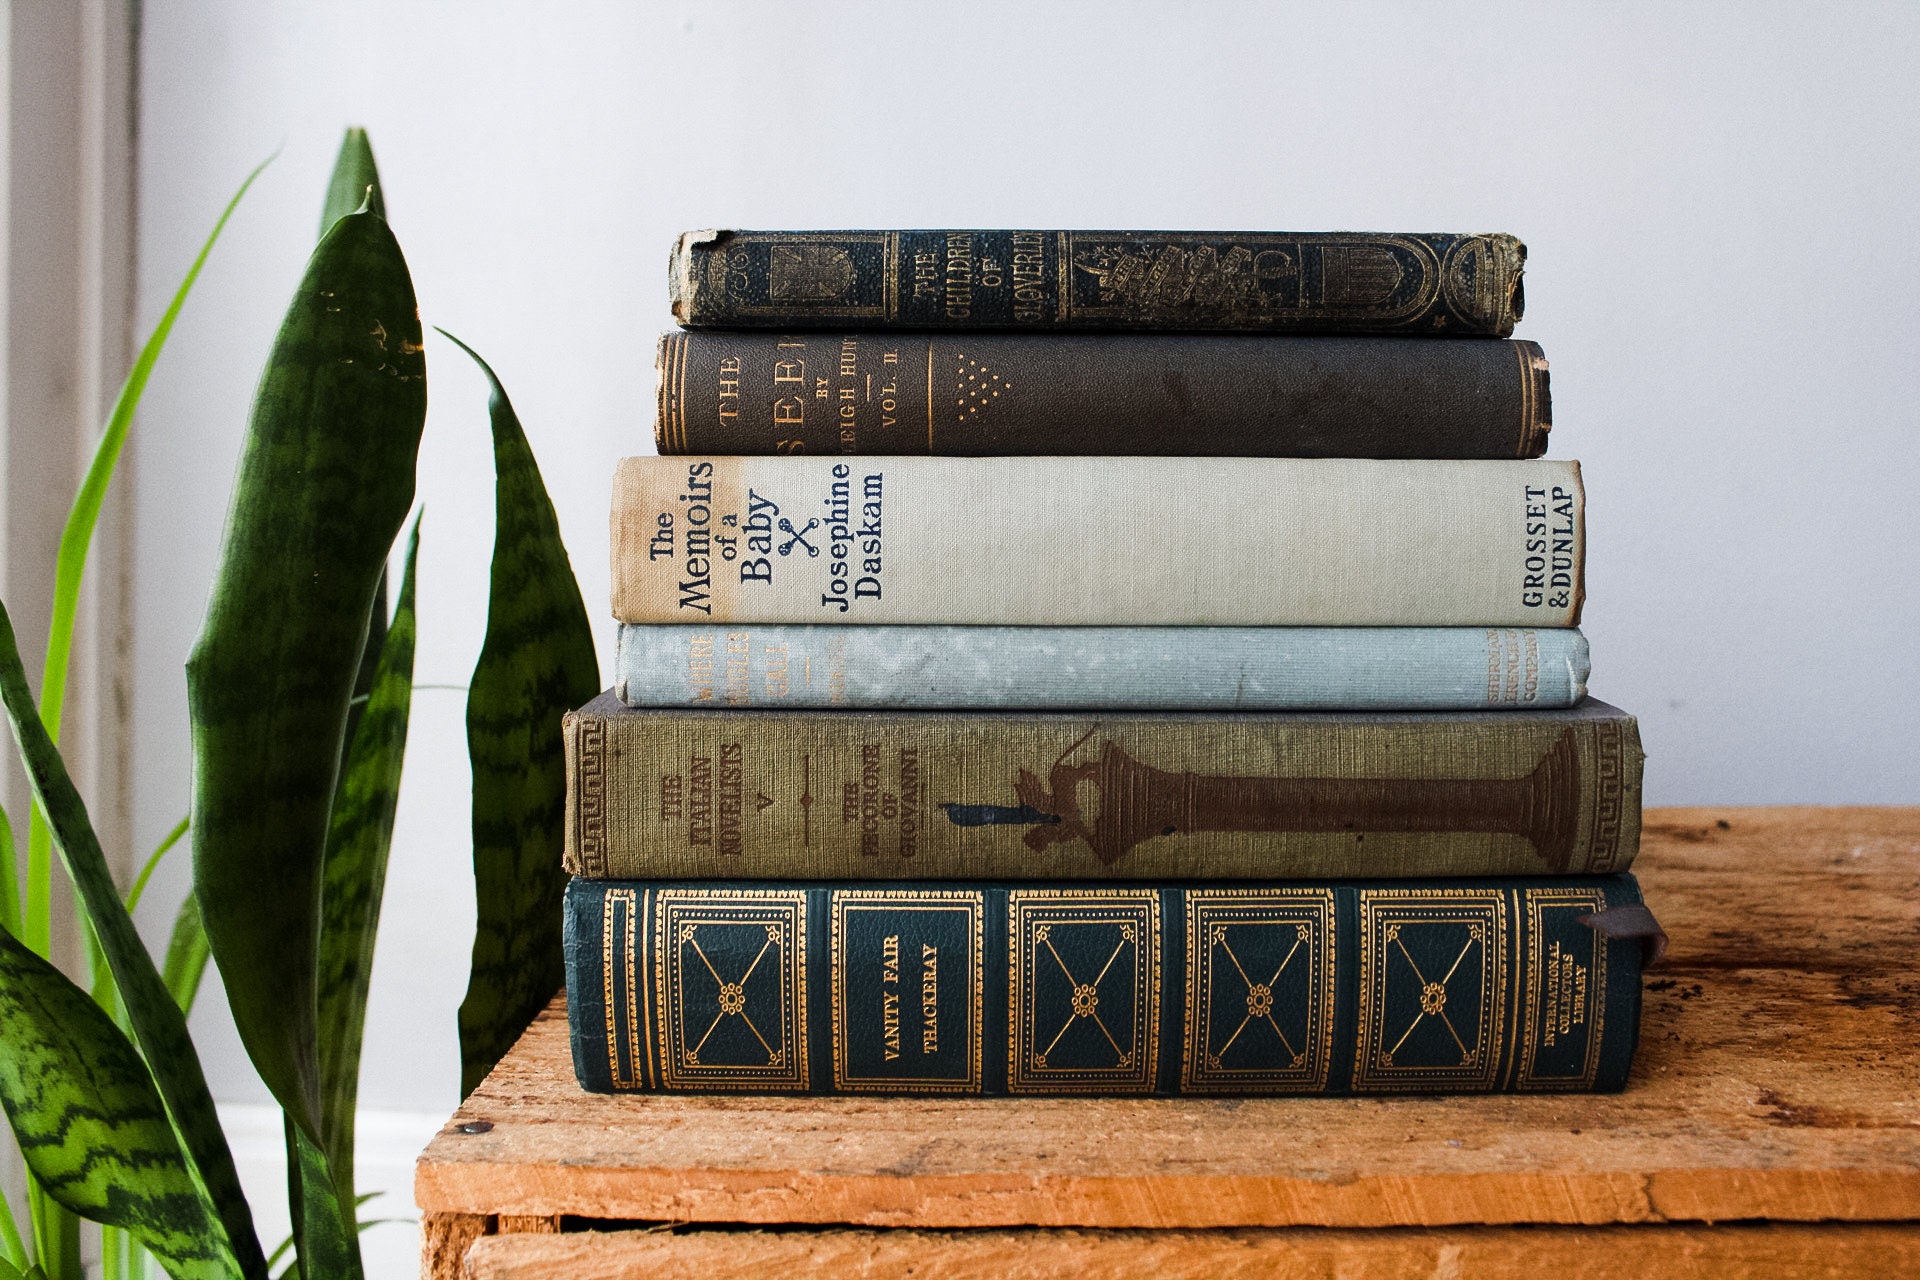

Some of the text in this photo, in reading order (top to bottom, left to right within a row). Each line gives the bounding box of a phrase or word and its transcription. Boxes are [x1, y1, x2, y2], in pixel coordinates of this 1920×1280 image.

[913, 252, 936, 297] THE
[945, 233, 972, 319] CHILDREN
[981, 257, 1003, 288] OF
[719, 356, 741, 427] THE
[816, 377, 829, 400] BY
[840, 386, 857, 454] LEIGH
[881, 375, 897, 429] VOL.
[650, 512, 674, 562] The
[678, 462, 713, 616] Memoirs
[714, 513, 738, 562] of a
[740, 488, 780, 585] Baby
[821, 463, 855, 613] Josephine
[854, 472, 884, 600] Daskam
[1522, 485, 1547, 608] GROSSET
[689, 632, 714, 703] WHERE
[725, 631, 750, 706] BUGLES
[765, 641, 790, 697] CALL
[1504, 643, 1519, 704] FRENCH
[1522, 629, 1538, 702] COMPANY
[661, 774, 682, 822] THE
[690, 755, 712, 847] ITALIAN
[719, 743, 743, 856] NOVELISTS
[757, 793, 775, 812] V
[843, 782, 859, 823] THE
[862, 745, 881, 858] PECORONE
[882, 793, 898, 820] OF
[899, 748, 919, 859] GIOVANNI
[883, 935, 900, 1062] VANITY FAIR
[922, 943, 938, 1054] THACKERAY
[1544, 941, 1560, 1047] INTERNATIONAL
[1559, 954, 1574, 1035] COLLECTORS
[1573, 965, 1587, 1024] LIBRARY
